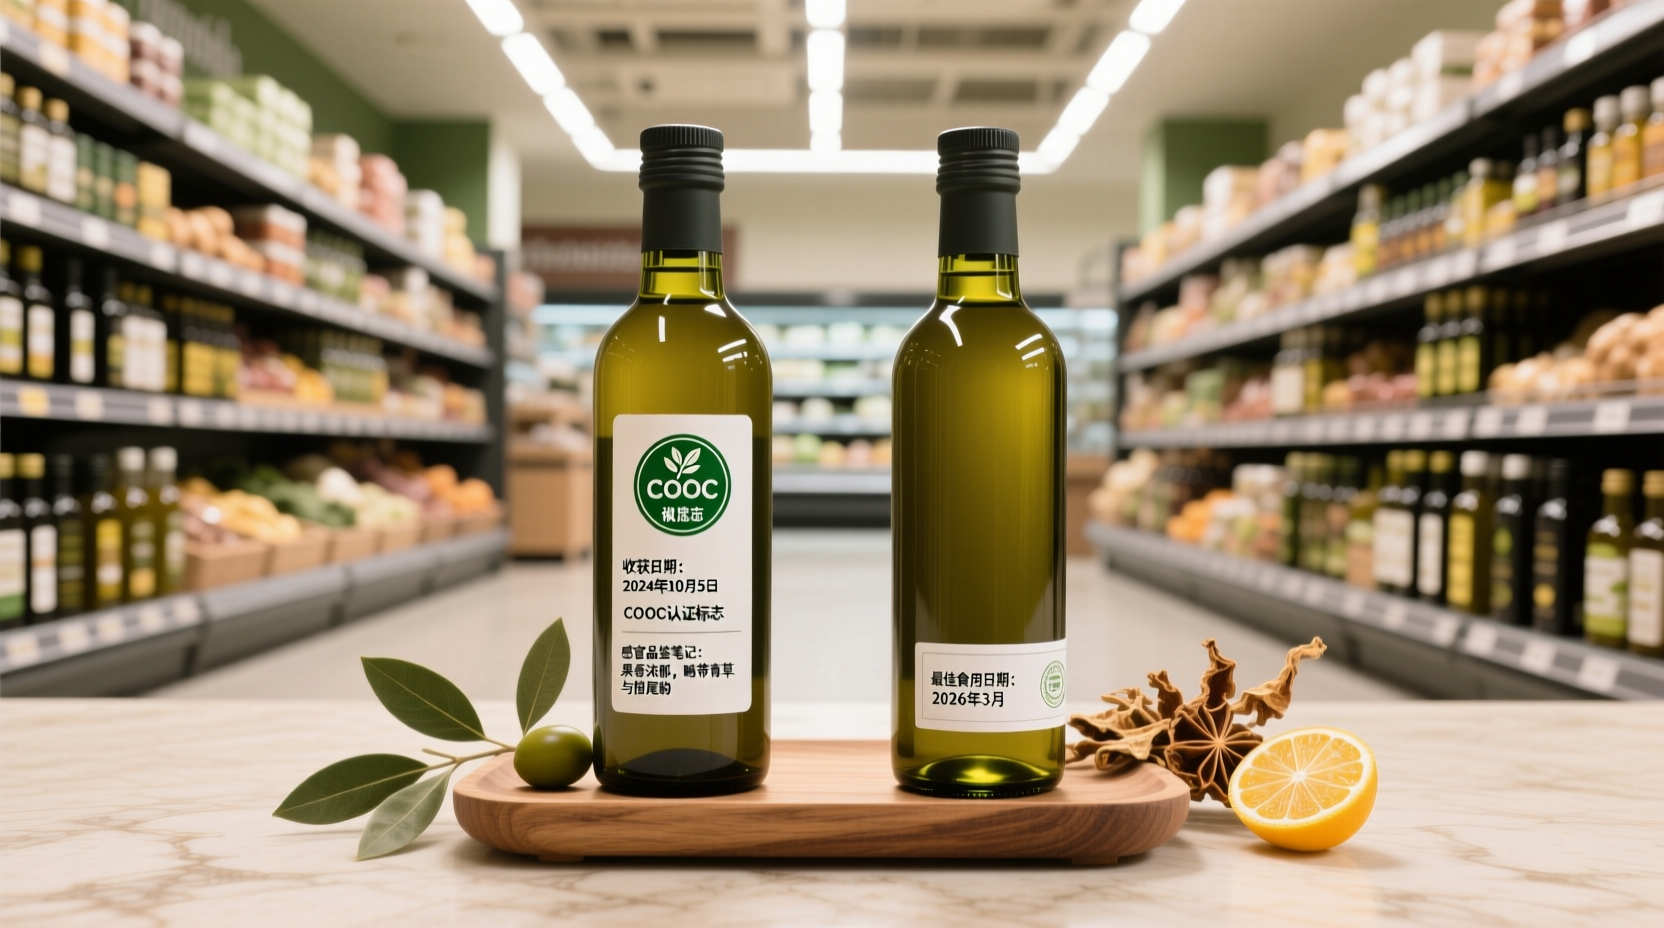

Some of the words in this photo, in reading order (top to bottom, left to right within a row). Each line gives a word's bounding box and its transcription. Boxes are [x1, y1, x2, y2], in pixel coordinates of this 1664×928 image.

[647, 479, 718, 499] COOC
[622, 558, 683, 574] 收获日期：
[622, 578, 718, 594] 2024年10月5日
[623, 604, 725, 621] COOC认证标志
[932, 691, 1004, 707] 2026年3月
